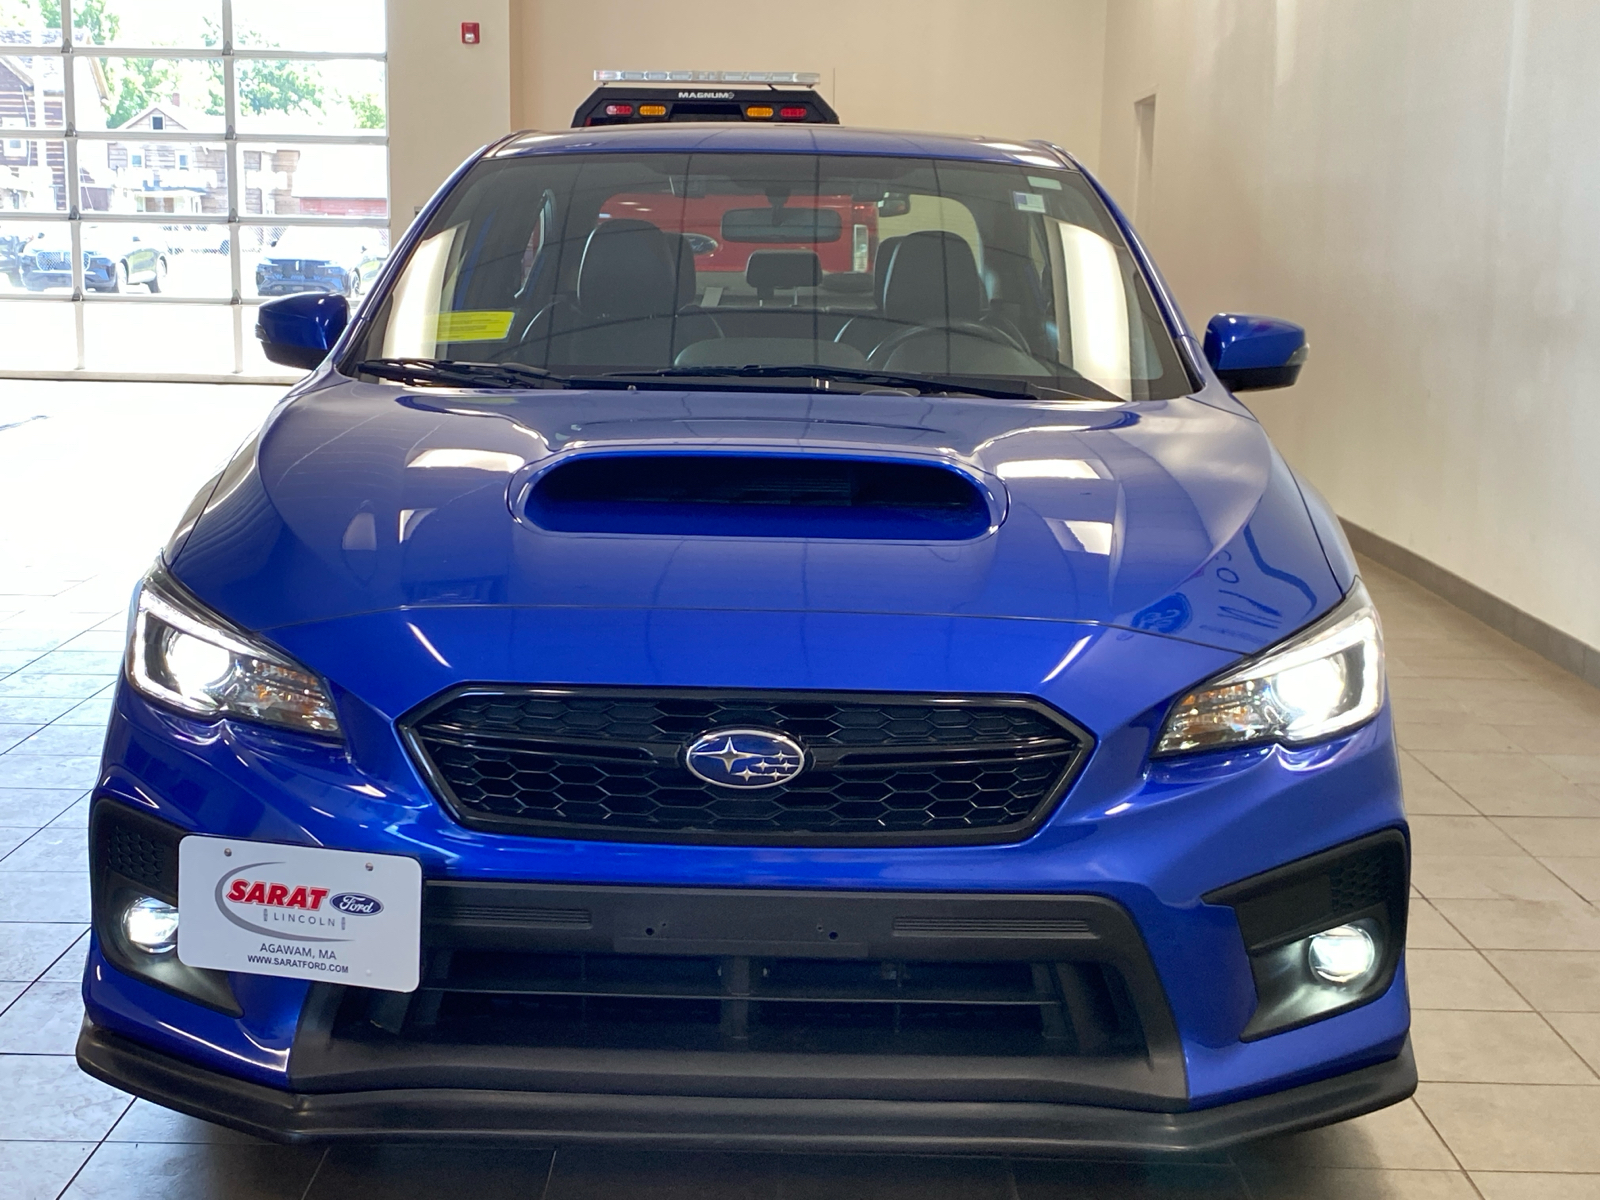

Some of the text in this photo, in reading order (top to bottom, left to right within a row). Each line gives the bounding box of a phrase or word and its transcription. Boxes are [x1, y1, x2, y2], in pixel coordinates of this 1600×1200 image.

[678, 91, 729, 99] MAGNUM
[226, 879, 376, 914] SARAT Ford
[273, 912, 336, 927] LINCOLN
[259, 943, 337, 961] AGAWAM, MA
[247, 955, 349, 974] WWW.SARATFORD.COM
